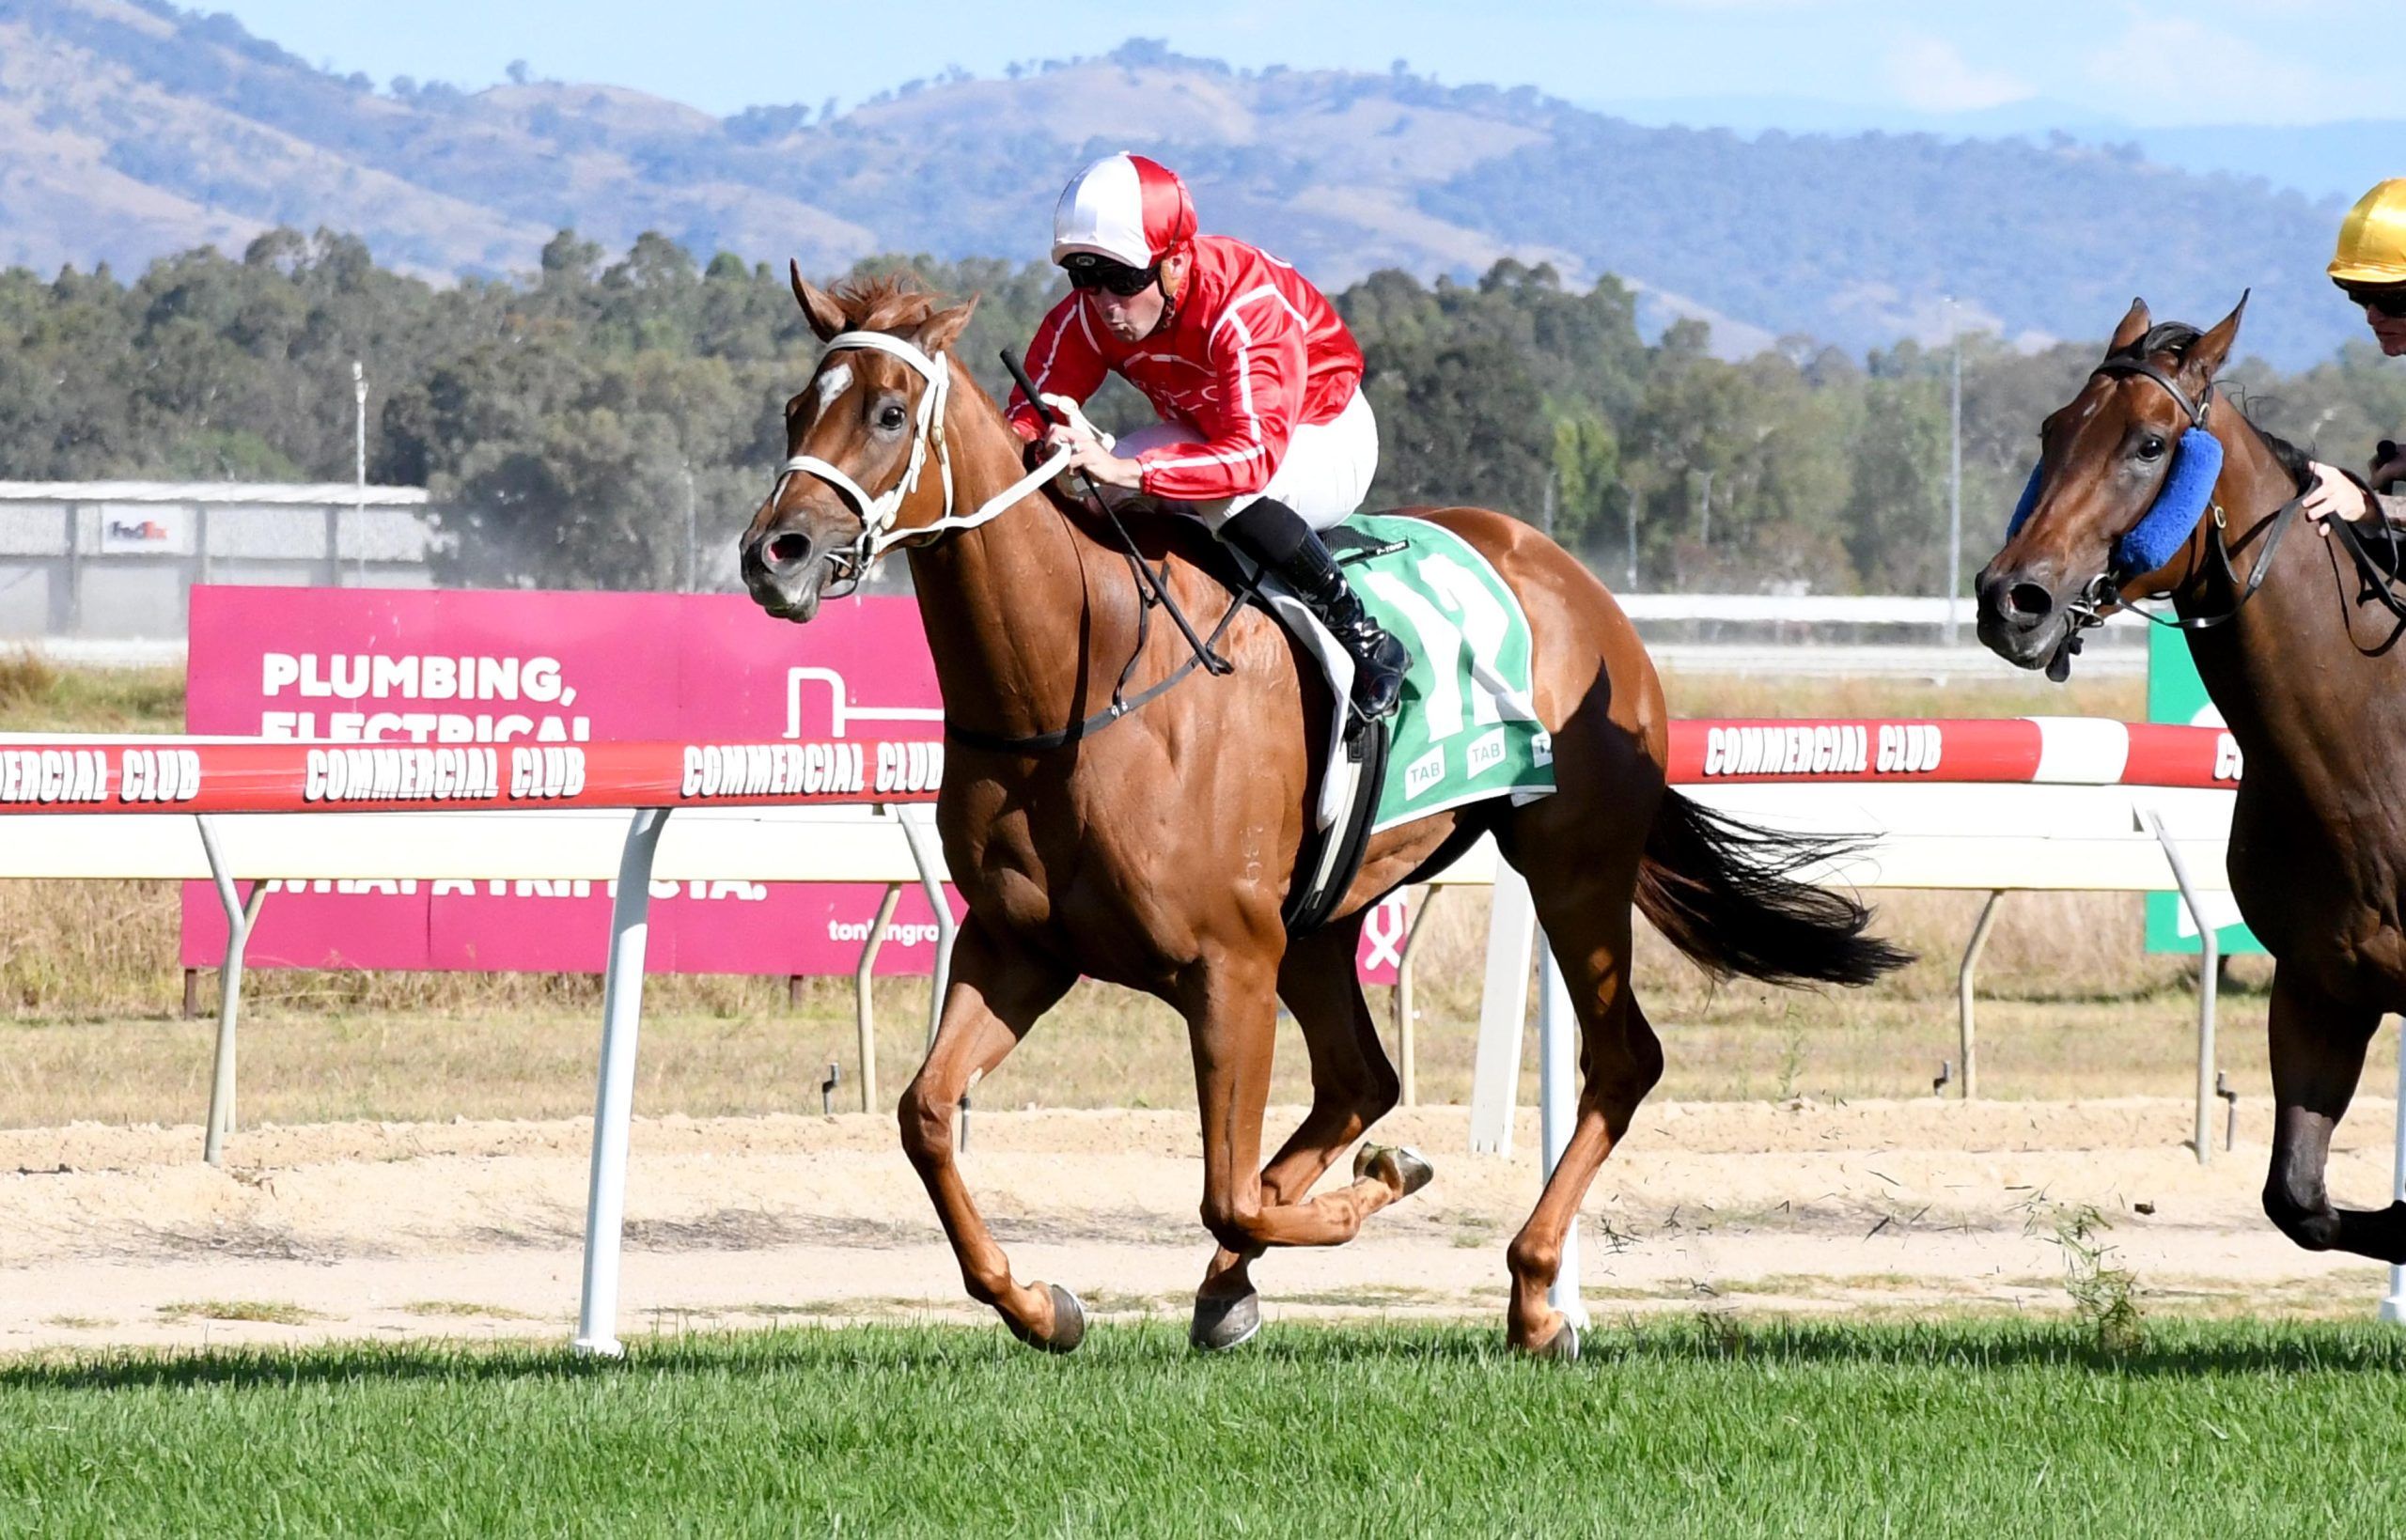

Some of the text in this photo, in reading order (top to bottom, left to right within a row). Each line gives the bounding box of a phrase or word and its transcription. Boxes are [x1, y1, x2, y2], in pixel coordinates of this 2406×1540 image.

[262, 652, 577, 707] PLUMBING,
[0, 749, 202, 802] ERCIAL CLUB
[305, 746, 586, 801] COMMERCIAL CLUB
[681, 741, 944, 798] COMMERCIAL CLUB
[1410, 762, 1442, 784] TAB
[1471, 741, 1502, 763] TAB
[1704, 723, 1942, 776] COMMERCIAL CLUB
